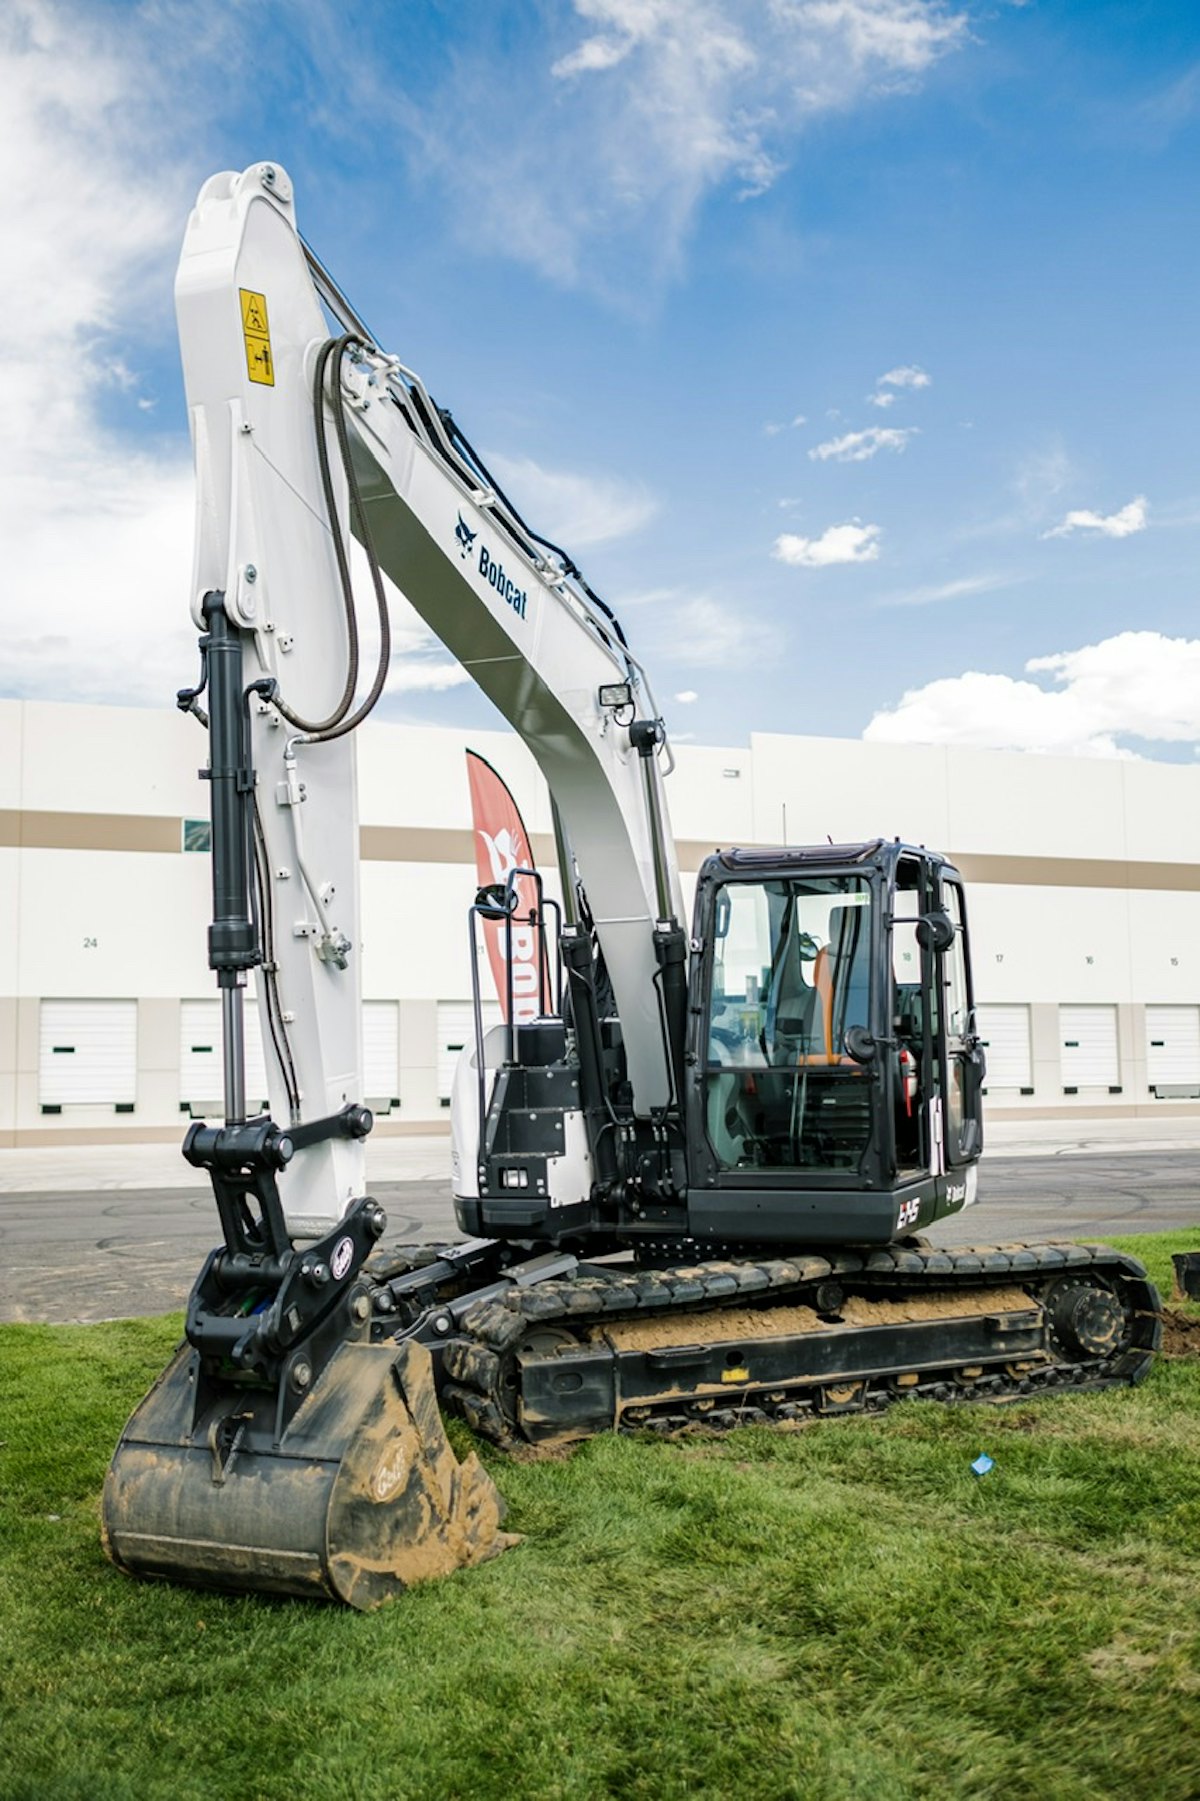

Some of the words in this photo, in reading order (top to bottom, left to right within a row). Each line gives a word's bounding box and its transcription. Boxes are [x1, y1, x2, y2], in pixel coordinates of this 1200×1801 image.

[478, 544, 527, 620] Bobcat
[83, 937, 98, 948] 24
[902, 952, 912, 962] 18
[995, 954, 1004, 963] 17
[1085, 956, 1095, 965] 16
[1170, 957, 1179, 966] 15
